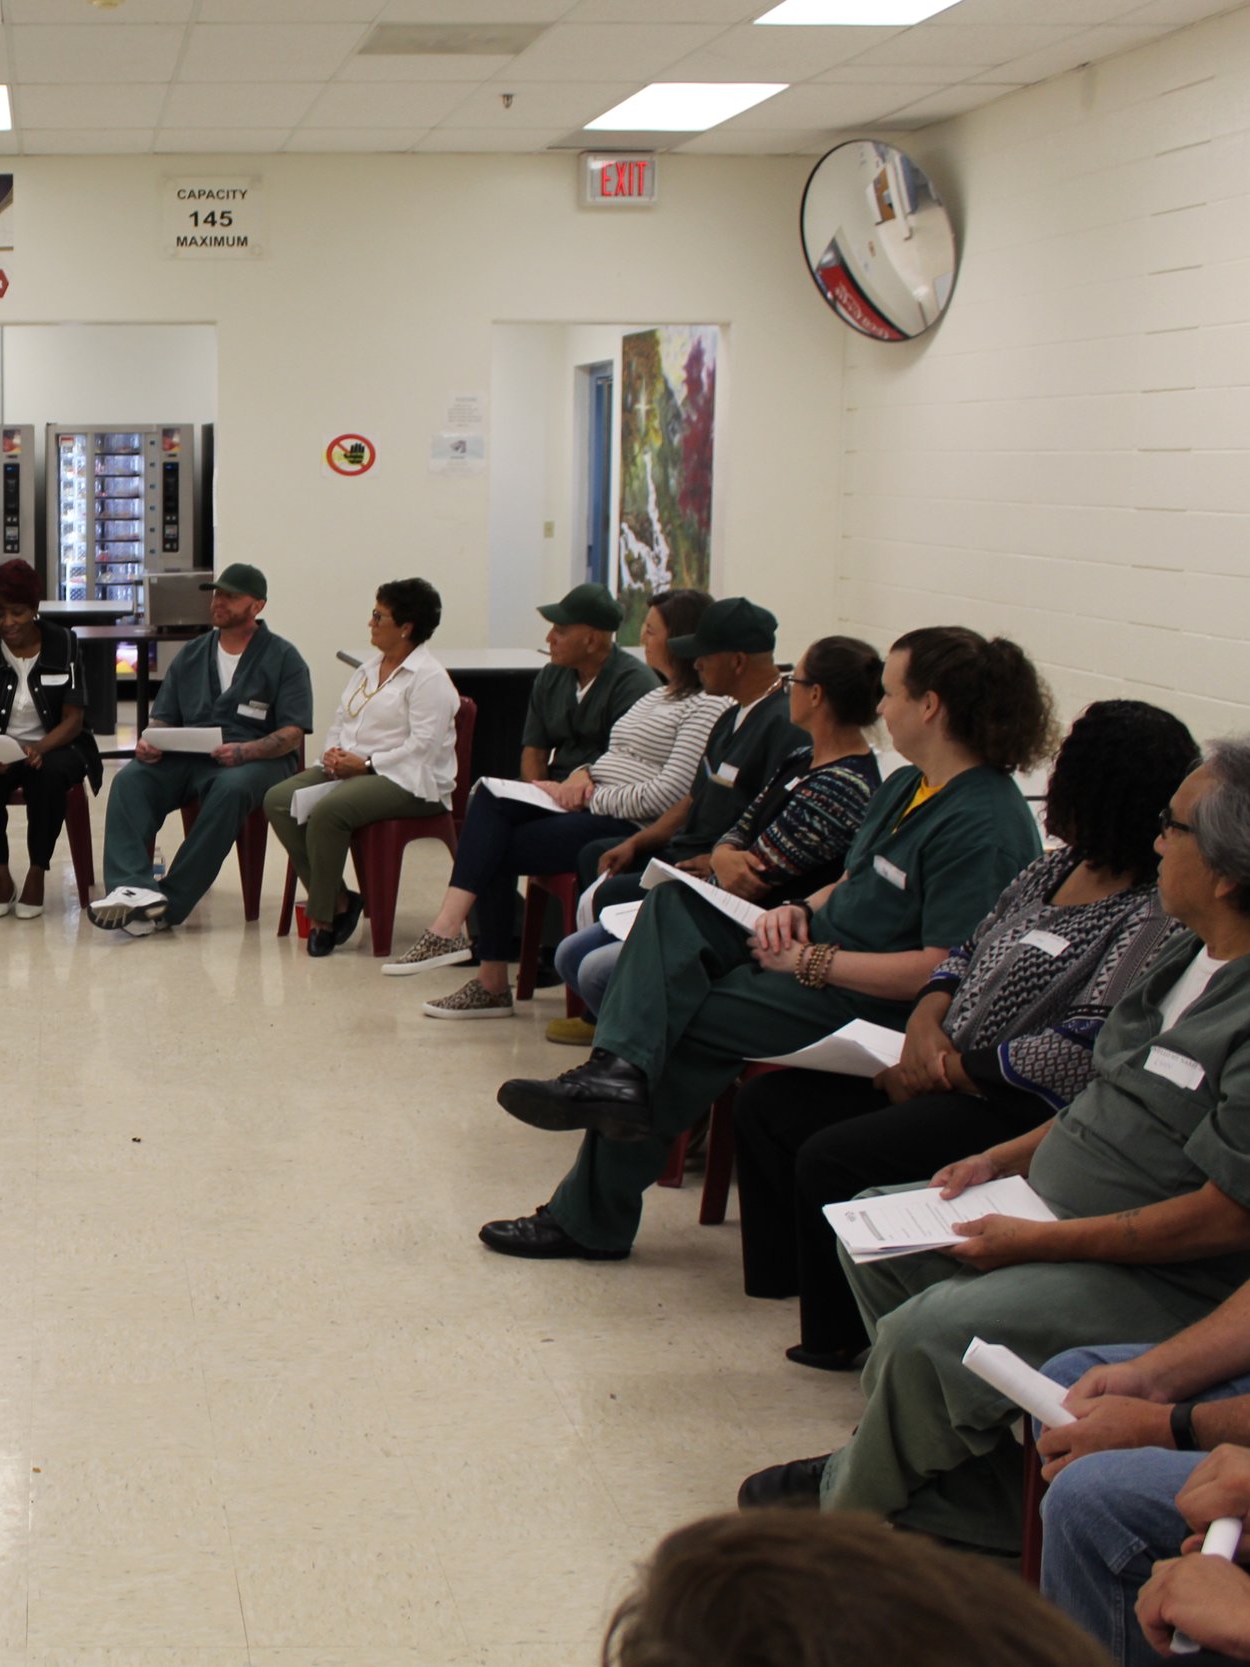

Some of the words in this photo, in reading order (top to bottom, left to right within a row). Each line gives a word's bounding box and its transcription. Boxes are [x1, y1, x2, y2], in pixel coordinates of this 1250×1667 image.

[601, 161, 648, 196] EXIT
[177, 189, 248, 200] CAPACITY
[189, 210, 233, 227] 145
[176, 235, 248, 247] MAXIMUM
